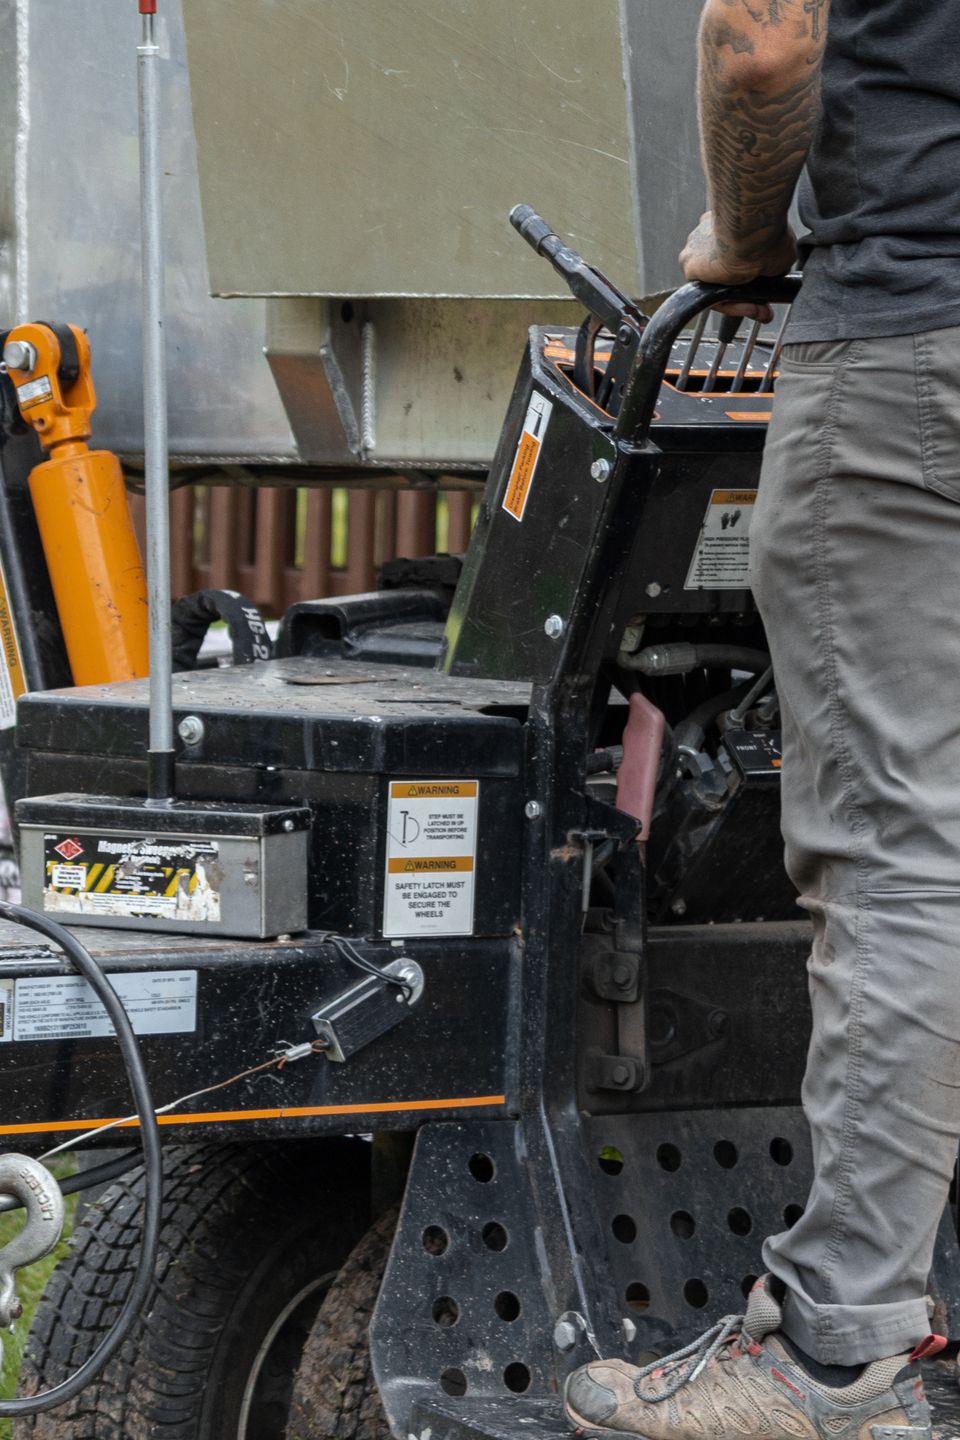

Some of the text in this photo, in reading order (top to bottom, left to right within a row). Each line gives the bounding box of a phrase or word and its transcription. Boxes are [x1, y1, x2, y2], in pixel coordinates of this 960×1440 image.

[418, 786, 459, 794] WARNING
[415, 861, 456, 869] WARNING
[395, 882, 421, 890] SAFETY
[446, 881, 465, 889] MUST
[413, 891, 446, 899] ENGAGED
